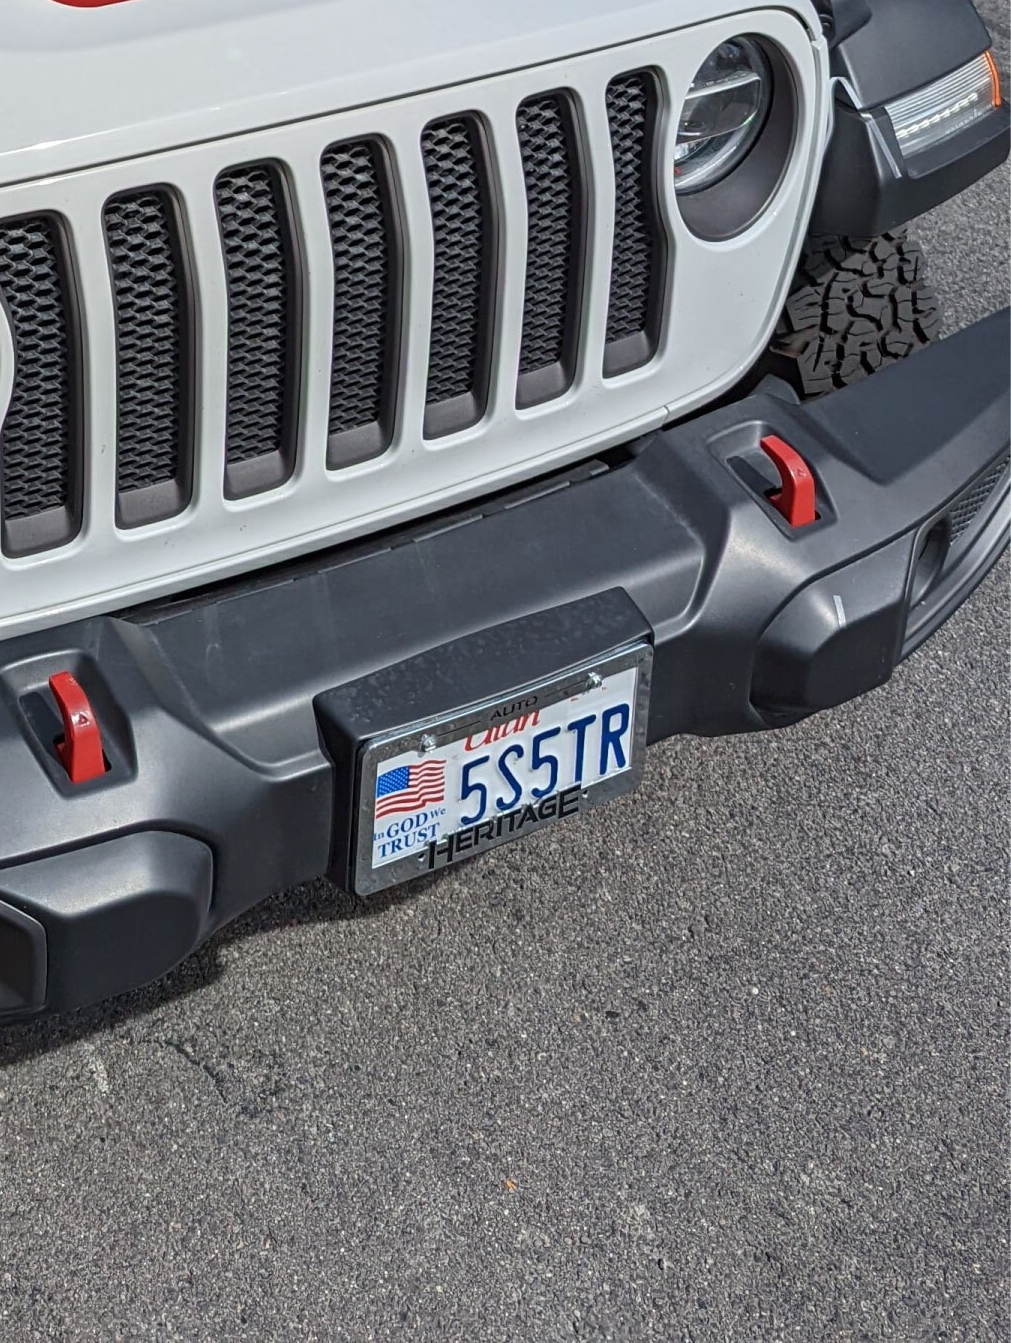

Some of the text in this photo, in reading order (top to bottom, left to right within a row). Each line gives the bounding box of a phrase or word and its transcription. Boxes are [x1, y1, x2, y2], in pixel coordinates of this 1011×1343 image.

[489, 695, 538, 721] AUTO
[459, 703, 630, 827] 5S5TR
[377, 822, 441, 859] TRUST
[387, 811, 429, 837] GOD
[429, 807, 447, 820] We
[428, 785, 580, 870] HERITAGE
